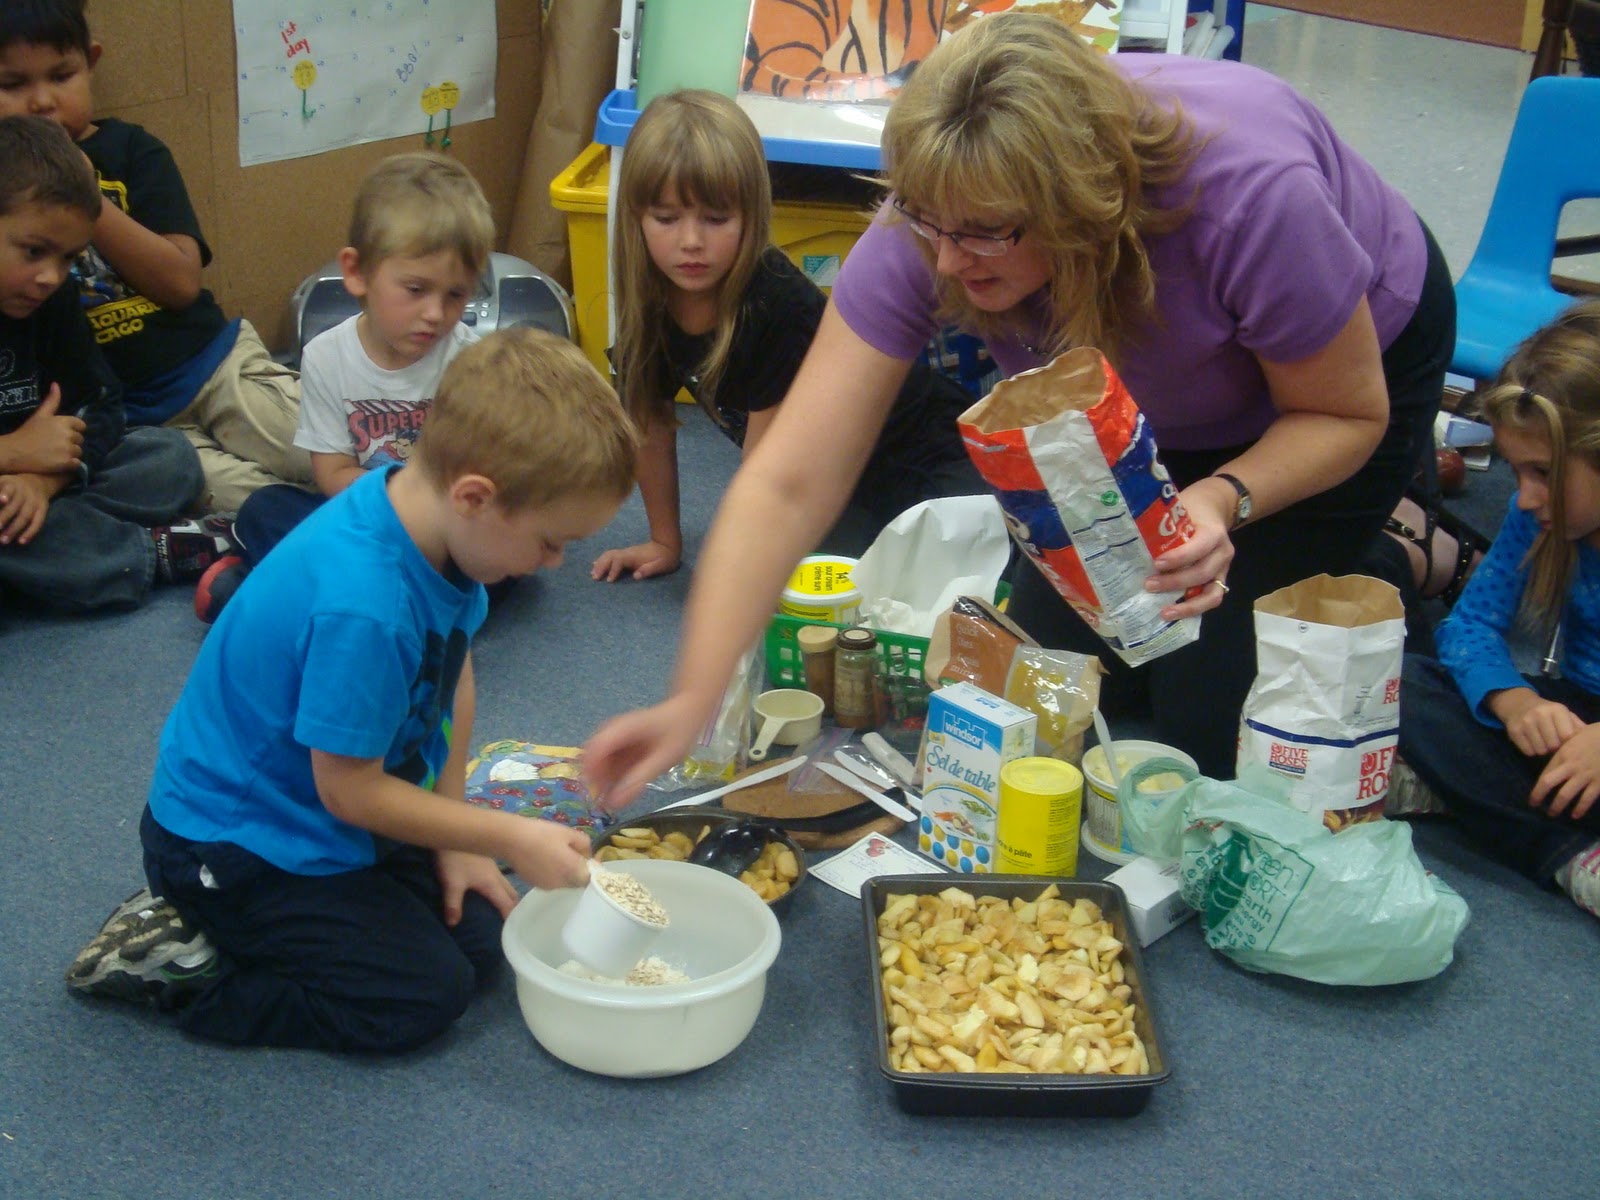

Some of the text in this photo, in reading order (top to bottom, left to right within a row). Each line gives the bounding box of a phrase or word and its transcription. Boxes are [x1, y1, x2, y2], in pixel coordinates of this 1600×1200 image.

[281, 20, 297, 45] 1st
[286, 38, 311, 58] day
[944, 721, 982, 746] windsor
[1270, 752, 1307, 769] ROSES
[1281, 746, 1309, 759] FIVE
[926, 745, 996, 793] Sel de table
